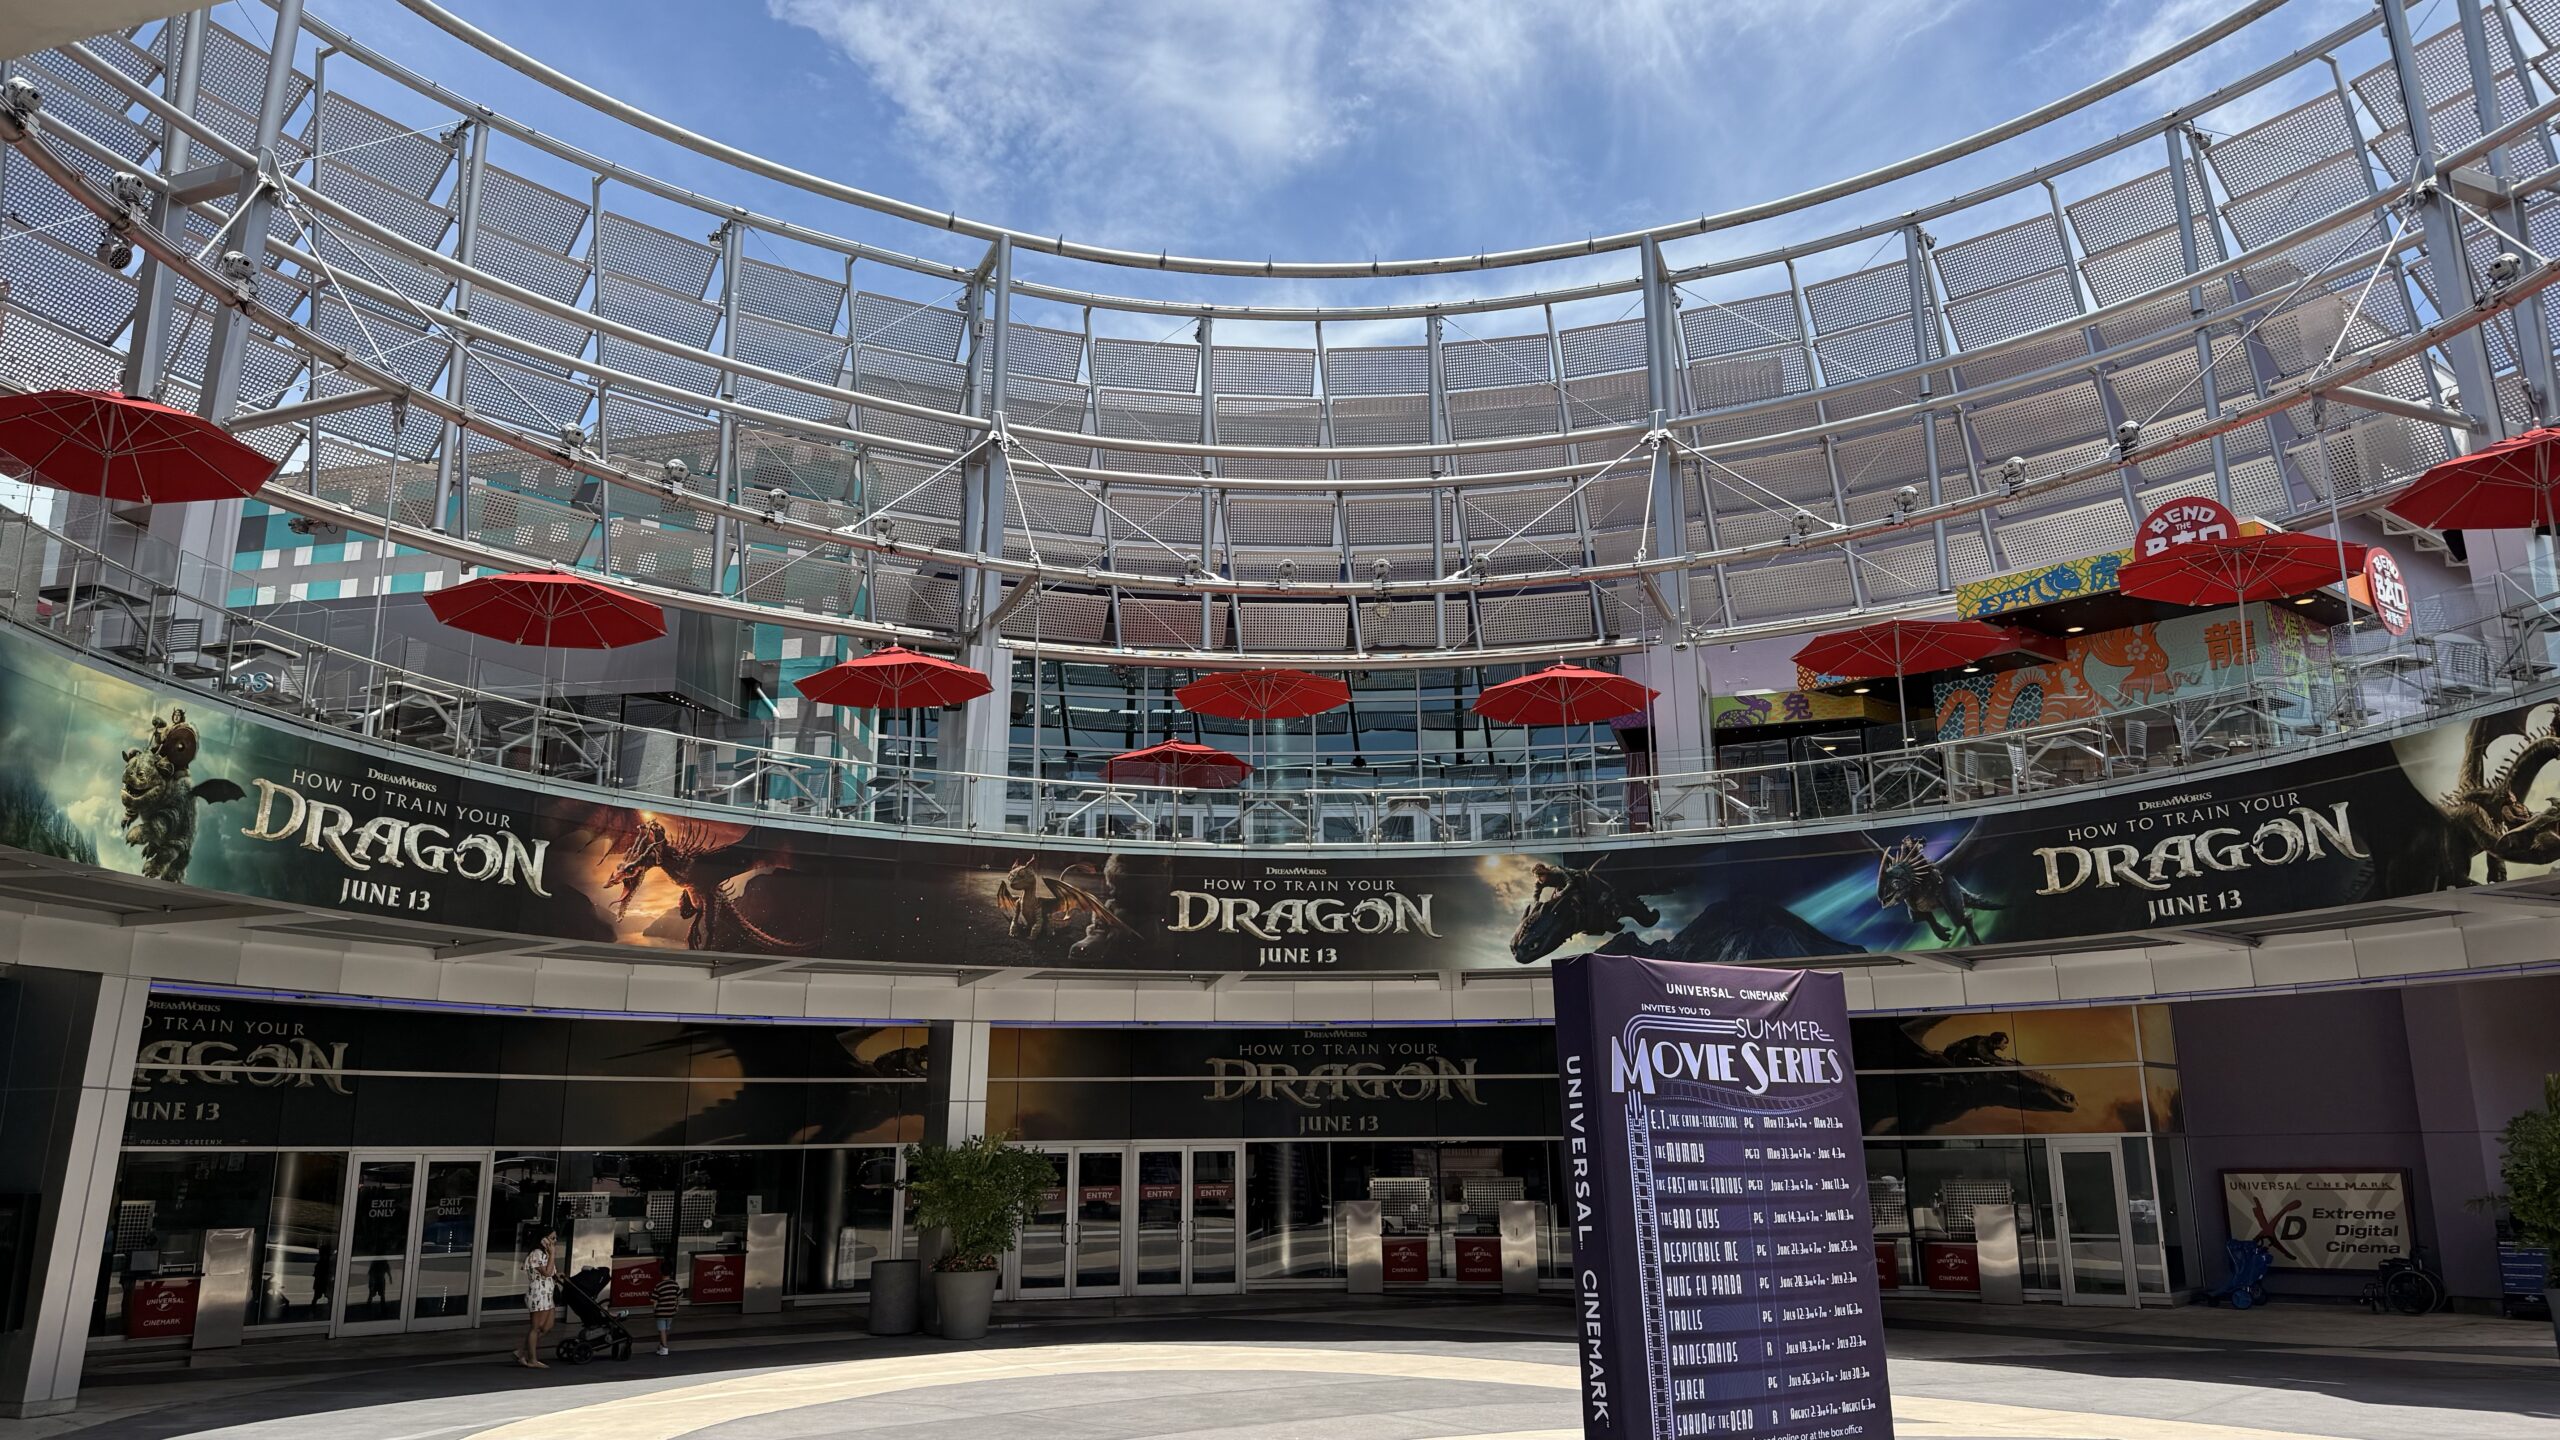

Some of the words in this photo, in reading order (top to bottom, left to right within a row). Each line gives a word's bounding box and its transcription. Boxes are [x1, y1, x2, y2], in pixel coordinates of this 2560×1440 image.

[2148, 505, 2216, 534] BEND
[2175, 521, 2191, 531] THE
[2372, 554, 2399, 579] BEND
[2374, 572, 2407, 611] BAO
[2203, 619, 2257, 670] 龍
[1783, 692, 1813, 721] 兔
[292, 769, 343, 794] HOW
[350, 782, 377, 801] TO
[384, 790, 448, 817] TRAIN
[456, 805, 511, 829] YOUR
[2068, 822, 2118, 842] HOW
[2126, 816, 2154, 833] TO
[2162, 803, 2230, 828] TRAIN
[2239, 792, 2300, 814] YOUR
[240, 777, 553, 898] DRAGON
[2032, 801, 2371, 896] DRAGON
[339, 877, 401, 909] JUNE
[408, 889, 431, 912] 13
[1203, 878, 1246, 892] HOW
[1252, 879, 1276, 892] TO
[1284, 879, 1338, 892] TRAIN
[1346, 879, 1396, 892] YOUR
[1167, 889, 1443, 941] DRAGON
[2147, 894, 2212, 923] JUNE
[2218, 889, 2243, 910] 13
[1259, 947, 1310, 967] JUNE
[1316, 948, 1338, 964] 13
[1666, 983, 1734, 999] UNIVERSAL
[1739, 989, 1789, 1001] CINEMARK
[1641, 1003, 1676, 1014] INVITES
[1678, 1006, 1697, 1015] YOU
[1699, 1007, 1711, 1016] TO
[164, 1016, 234, 1033] TRAIN
[244, 1021, 305, 1037] YOUR
[1735, 1017, 1830, 1042] SUMMER
[1239, 1044, 1284, 1056] HOW
[1291, 1044, 1316, 1056] TO
[1322, 1043, 1380, 1056] TRAIN
[1388, 1043, 1439, 1055] YOUR
[131, 1037, 353, 1095] AGON
[1611, 1035, 1740, 1094] MOVIE
[1741, 1041, 1844, 1095] SERIES
[1203, 1056, 1488, 1109] DRAGON
[131, 1101, 187, 1121] UNE
[195, 1102, 221, 1121] 13
[1650, 1109, 1670, 1130] E.T.
[1743, 1116, 1754, 1129] PG
[1299, 1115, 1352, 1136] JUNE
[1359, 1115, 1379, 1132] 13
[1654, 1145, 1666, 1159] THE
[1666, 1142, 1705, 1163] MUMMY
[1086, 1191, 1113, 1200] ENTRY
[1147, 1190, 1174, 1198] ENTRY
[1200, 1189, 1227, 1197] ENTRY
[1655, 1179, 1666, 1191] THE
[1667, 1176, 1686, 1194] FAST
[1710, 1177, 1743, 1194] FURIOUS
[2229, 1181, 2301, 1191] UNIVERSAL
[2306, 1182, 2396, 1191] CINEMARK
[371, 1199, 396, 1208] EXIT
[437, 1207, 464, 1216] ONLY
[440, 1197, 463, 1207] EXIT
[368, 1208, 396, 1218] ONLY
[1660, 1212, 1673, 1226] THE
[1672, 1208, 1692, 1229] BAD
[1695, 1208, 1720, 1229] GUYS
[1753, 1211, 1764, 1224] PG
[2312, 1208, 2396, 1220] Extreme
[1566, 1055, 1593, 1242] UNIVERSAL
[1582, 1269, 1610, 1422] CINEMARK
[2253, 1196, 2307, 1261] XD
[2335, 1225, 2399, 1239] Digital
[1663, 1241, 1721, 1263] DESPICABLE
[1724, 1241, 1739, 1262] ME
[1756, 1244, 1767, 1257] PG
[2325, 1241, 2401, 1254] Cinema
[1666, 1275, 1692, 1297] KUNG
[1695, 1275, 1708, 1296] FU
[1711, 1273, 1743, 1296] PANDA
[1759, 1276, 1770, 1289] PG
[146, 1297, 185, 1306] UNIVERSAL
[143, 1318, 181, 1327] CINEMARK
[1668, 1309, 1703, 1332] TROLLS
[1762, 1310, 1773, 1323] PG
[1672, 1341, 1739, 1366] BRIDESMAIDS
[1766, 1341, 1773, 1357] R
[1674, 1378, 1706, 1402] SHREK
[1767, 1376, 1778, 1389] PG
[1676, 1412, 1708, 1437] SHAUN
[1708, 1415, 1716, 1430] OF
[1718, 1414, 1730, 1429] THE
[1730, 1408, 1754, 1432] DEAD
[1772, 1409, 1779, 1425] R
[1809, 1432, 1817, 1440] at
[1818, 1429, 1830, 1439] the
[1830, 1427, 1844, 1437] box
[1844, 1424, 1863, 1435] office
